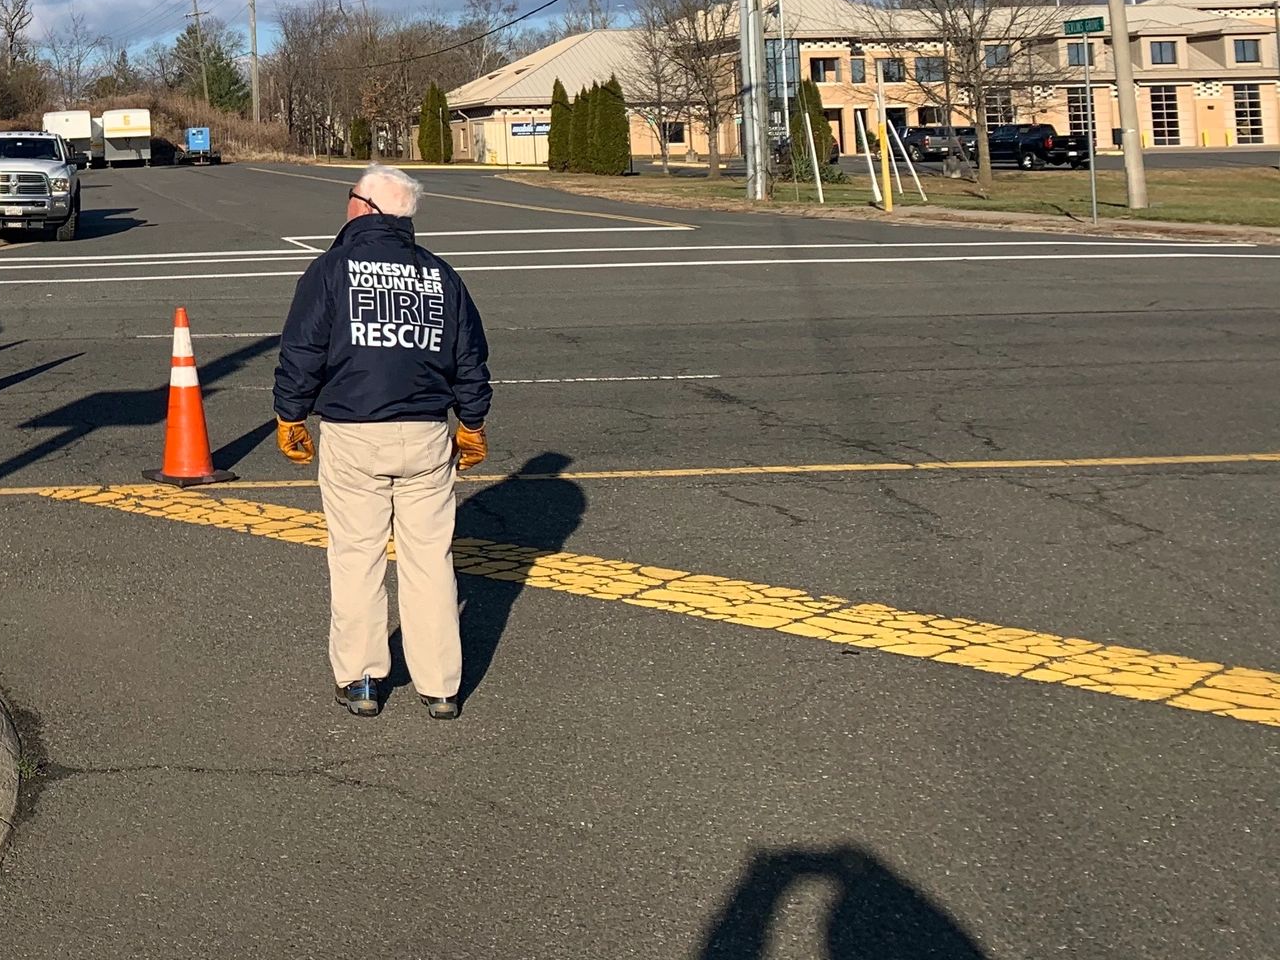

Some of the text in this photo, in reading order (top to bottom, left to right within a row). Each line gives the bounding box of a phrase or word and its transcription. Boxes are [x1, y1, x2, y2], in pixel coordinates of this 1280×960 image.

[349, 273, 443, 294] VOLUNTEER
[349, 286, 444, 328] FIRE
[350, 322, 443, 352] RESCUE
